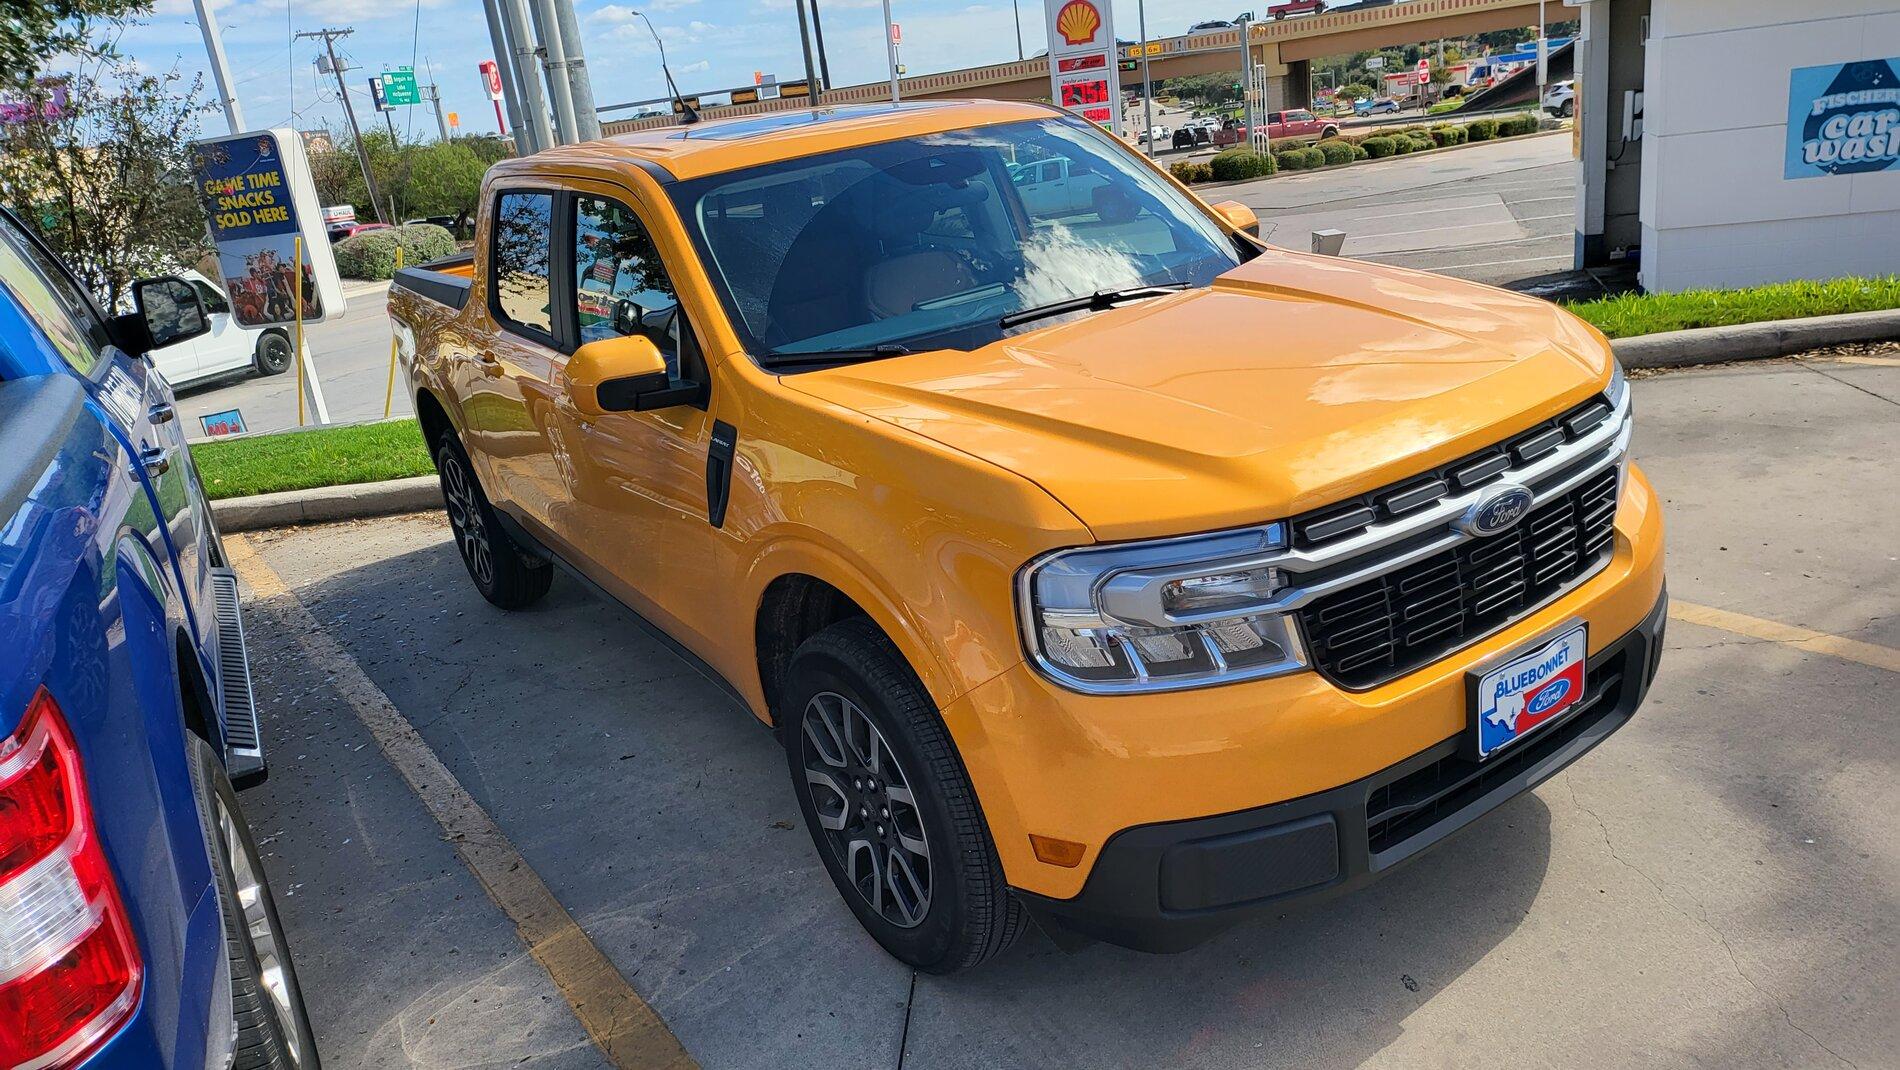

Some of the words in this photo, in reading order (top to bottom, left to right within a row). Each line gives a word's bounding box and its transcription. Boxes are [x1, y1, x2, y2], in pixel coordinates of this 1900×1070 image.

[1811, 89, 1900, 115] FISCHER
[1823, 112, 1899, 139] car
[247, 171, 281, 189] TIME
[218, 191, 275, 211] SNACKS
[215, 211, 252, 229] SOLD
[253, 206, 289, 224] HERE
[1490, 498, 1521, 527] Ford
[1496, 646, 1569, 698] BLUEBONNET
[1535, 685, 1564, 710] Ford
